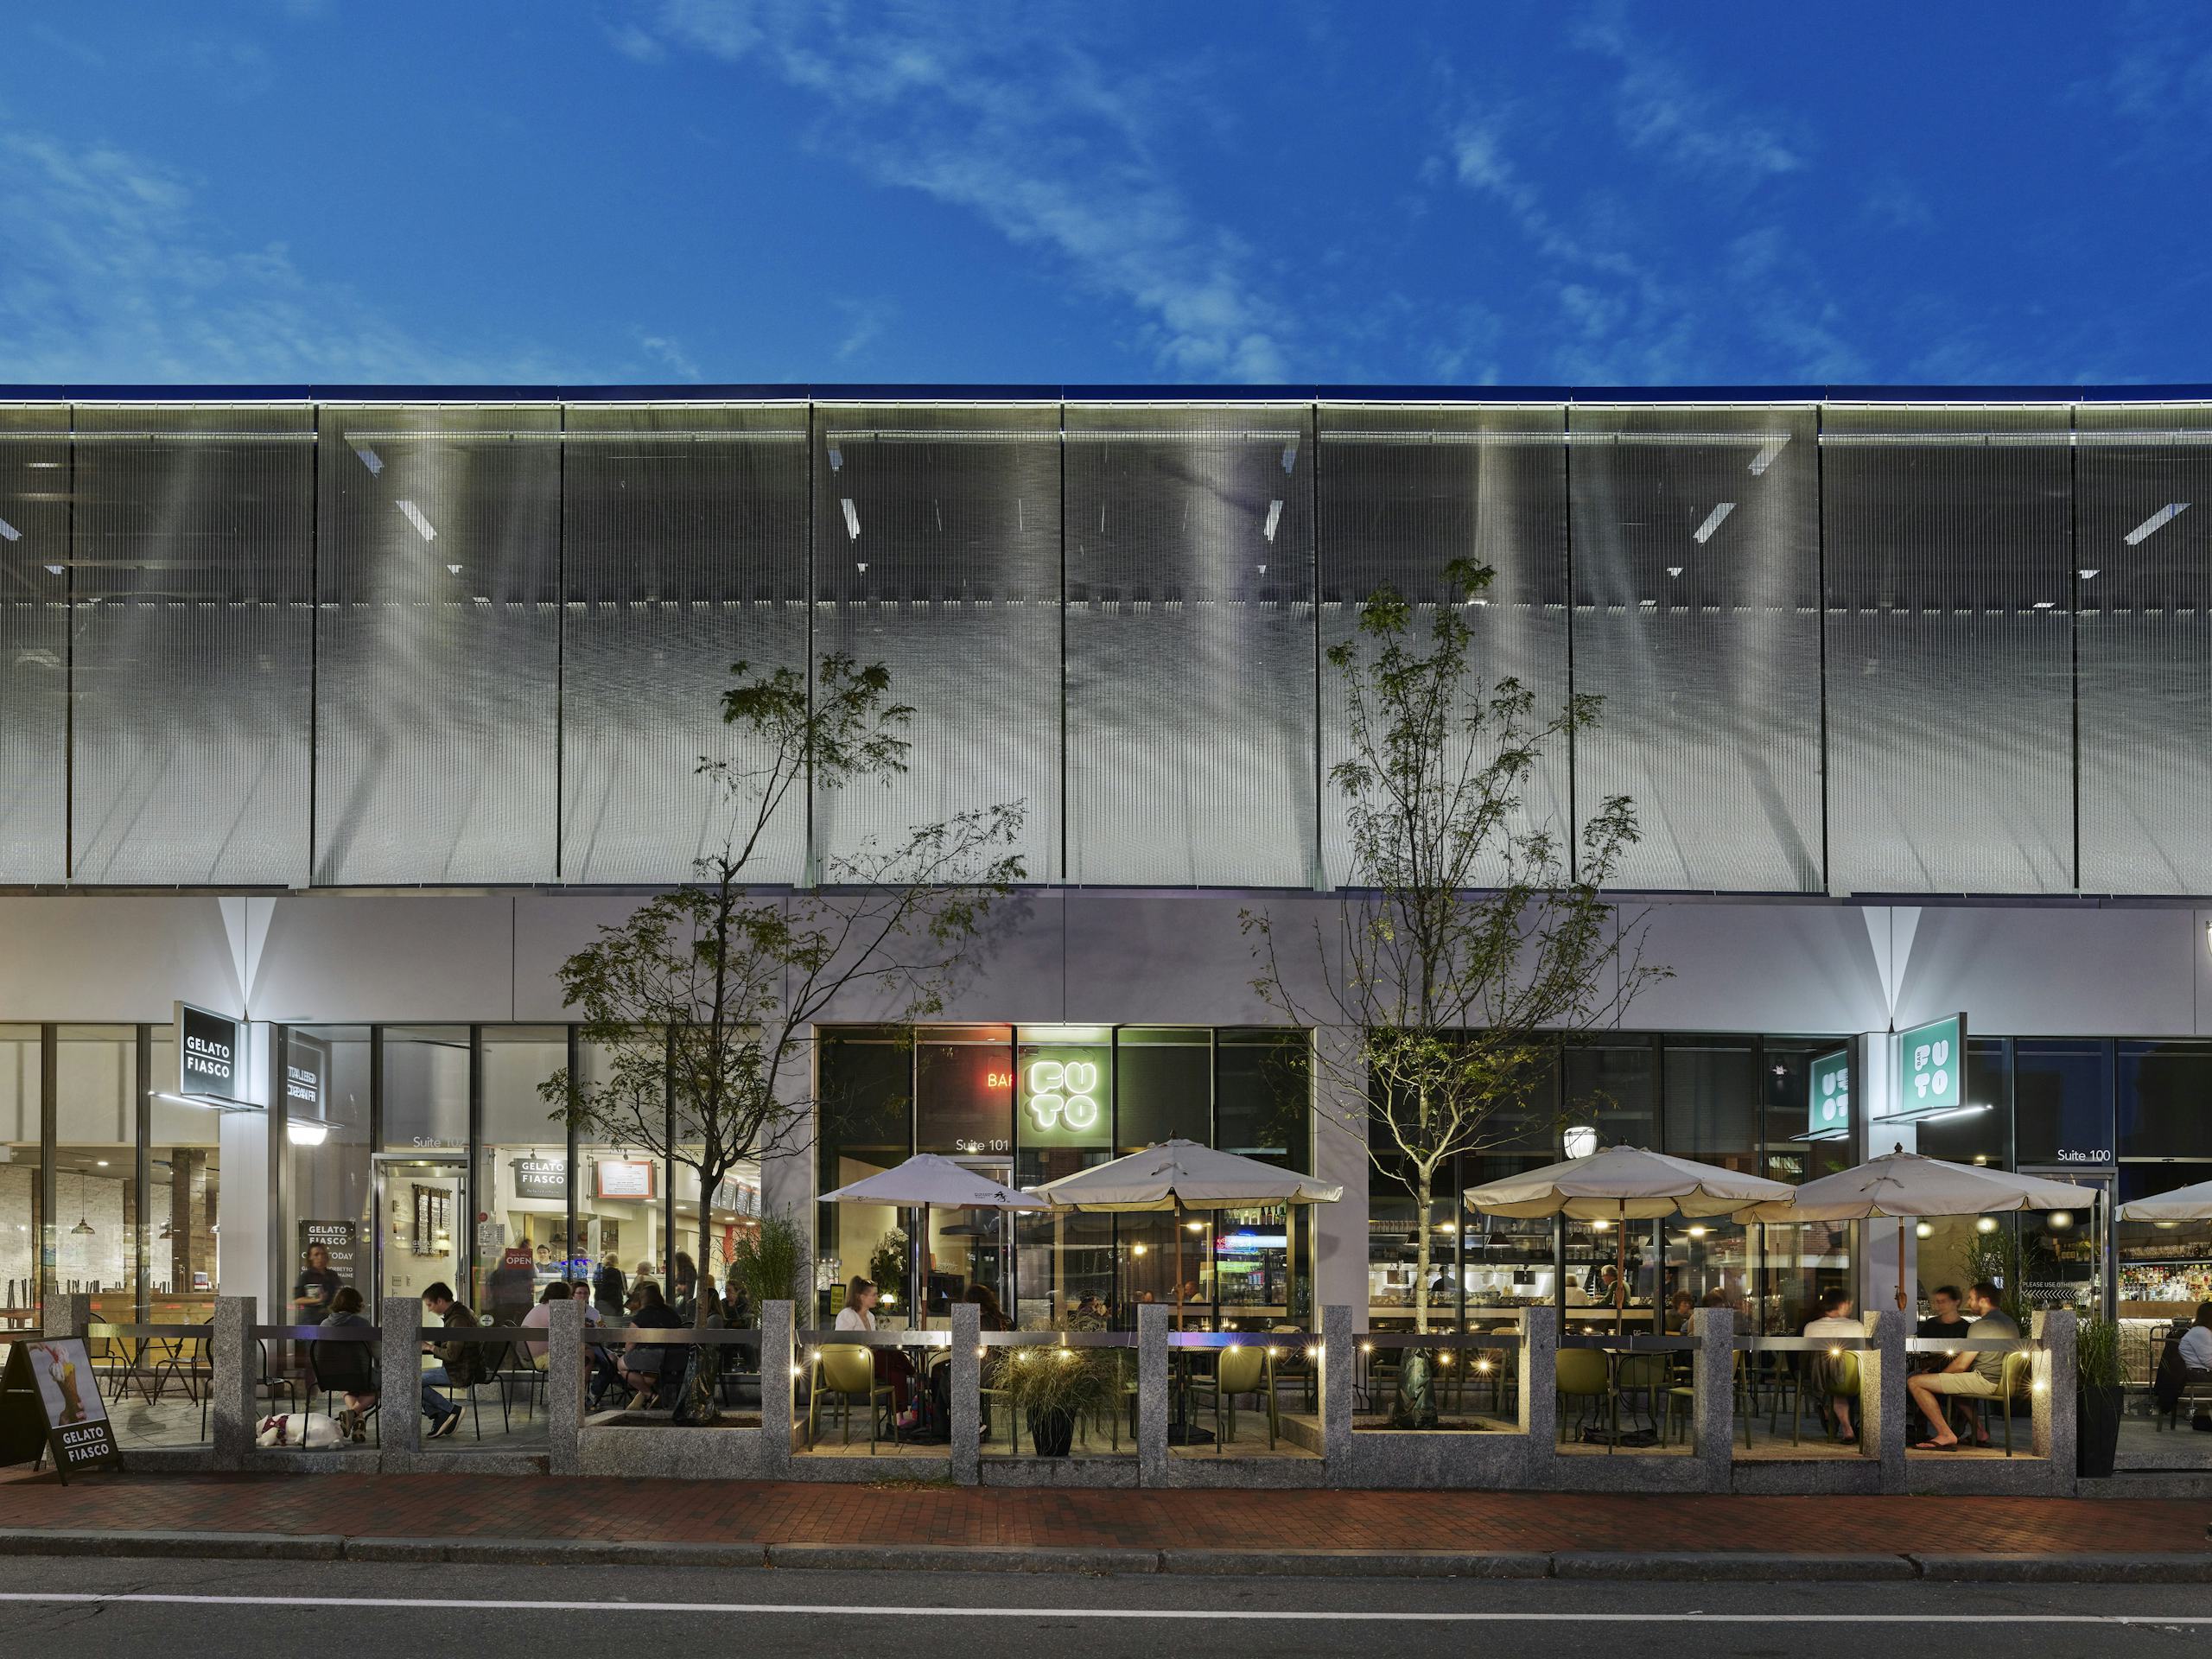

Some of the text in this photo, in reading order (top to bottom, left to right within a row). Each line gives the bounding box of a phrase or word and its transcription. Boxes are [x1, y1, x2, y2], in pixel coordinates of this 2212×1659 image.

[187, 1035, 230, 1058] GELATO
[1915, 1039, 1949, 1071] FU
[188, 1056, 230, 1078] FIASCO
[1031, 1061, 1097, 1095] FU
[1915, 1070, 1948, 1099] TO
[1031, 1094, 1097, 1128] TO
[413, 1136, 442, 1147] Suite
[956, 1139, 1008, 1151] Suite 101
[2057, 1149, 2111, 1161] Suite 100
[522, 1161, 564, 1172] GELATO
[522, 1175, 564, 1184] FIASCO
[309, 1236, 346, 1245] FIASCO
[506, 1256, 532, 1265] OPEN
[62, 1427, 104, 1444] GELATO
[68, 1443, 109, 1462] FIASCO
